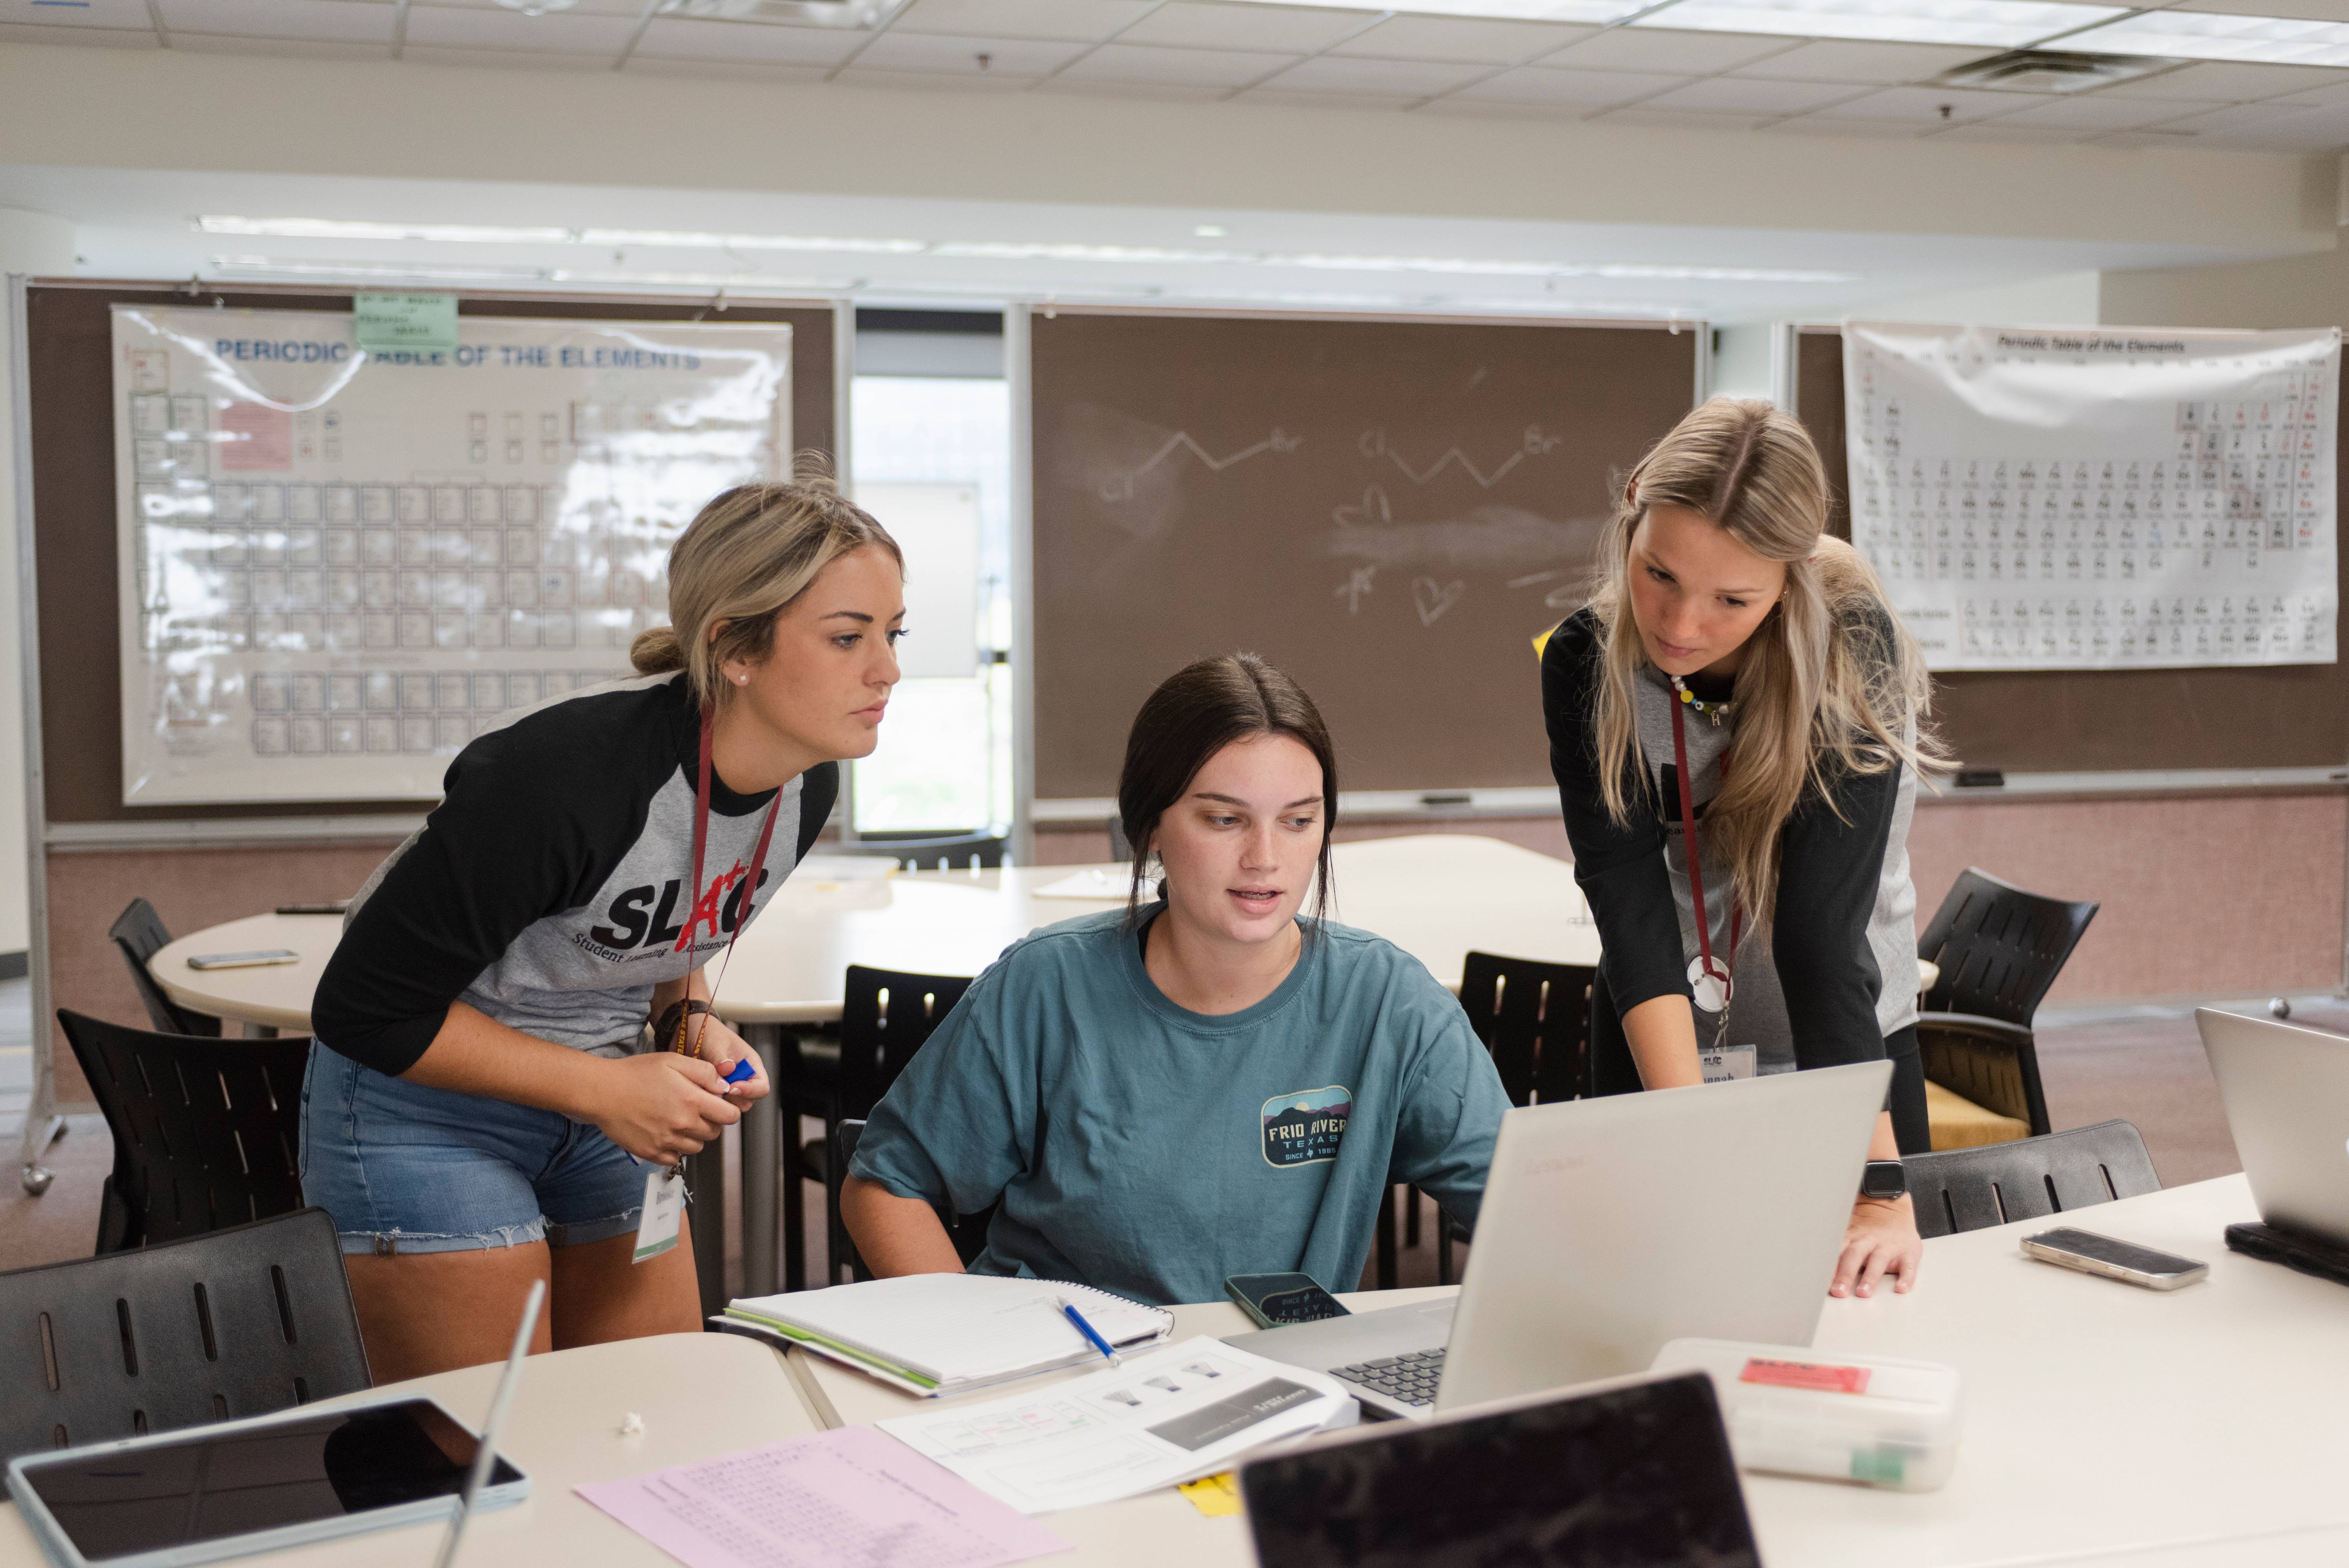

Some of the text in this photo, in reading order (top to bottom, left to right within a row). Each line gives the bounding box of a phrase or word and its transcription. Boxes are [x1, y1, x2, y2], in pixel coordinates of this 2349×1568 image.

[216, 339, 701, 370] PERIODIC ABLE OF THE ELEMENTS
[1998, 335, 2047, 349] Periodic
[2052, 337, 2082, 351] Table
[2127, 339, 2185, 352] Elements
[572, 933, 729, 963] Student Learning Asistance
[677, 1029, 686, 1054] STATE
[1269, 1119, 1346, 1141] FRIO RIVER
[1283, 1135, 1338, 1149] TEXAS
[1285, 1152, 1303, 1160] SINCE
